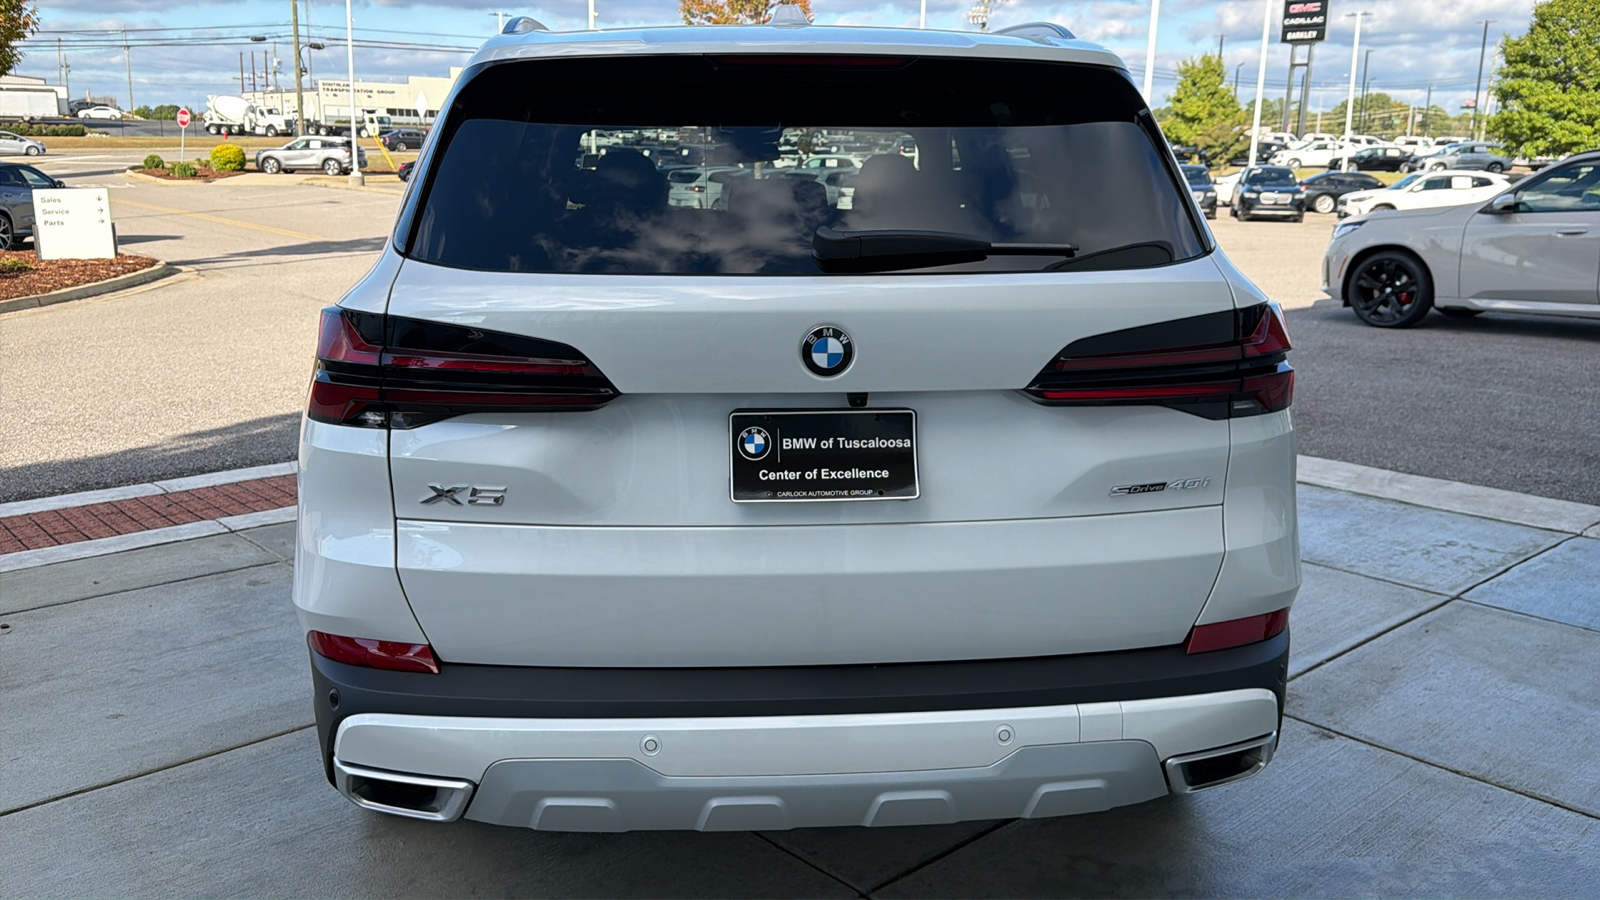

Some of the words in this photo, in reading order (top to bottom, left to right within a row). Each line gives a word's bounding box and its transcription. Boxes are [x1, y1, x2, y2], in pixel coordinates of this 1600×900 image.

[1289, 2, 1321, 13] GMC
[1284, 16, 1324, 25] CADILLAC
[1286, 30, 1317, 40] BARKLEY
[806, 328, 850, 345] BMW
[782, 438, 817, 450] BMW
[820, 438, 834, 449] of
[837, 437, 911, 449] Tuscaloosa
[758, 469, 801, 481] Center
[804, 468, 818, 480] of
[821, 467, 890, 480] Excellence
[419, 483, 508, 506] X5
